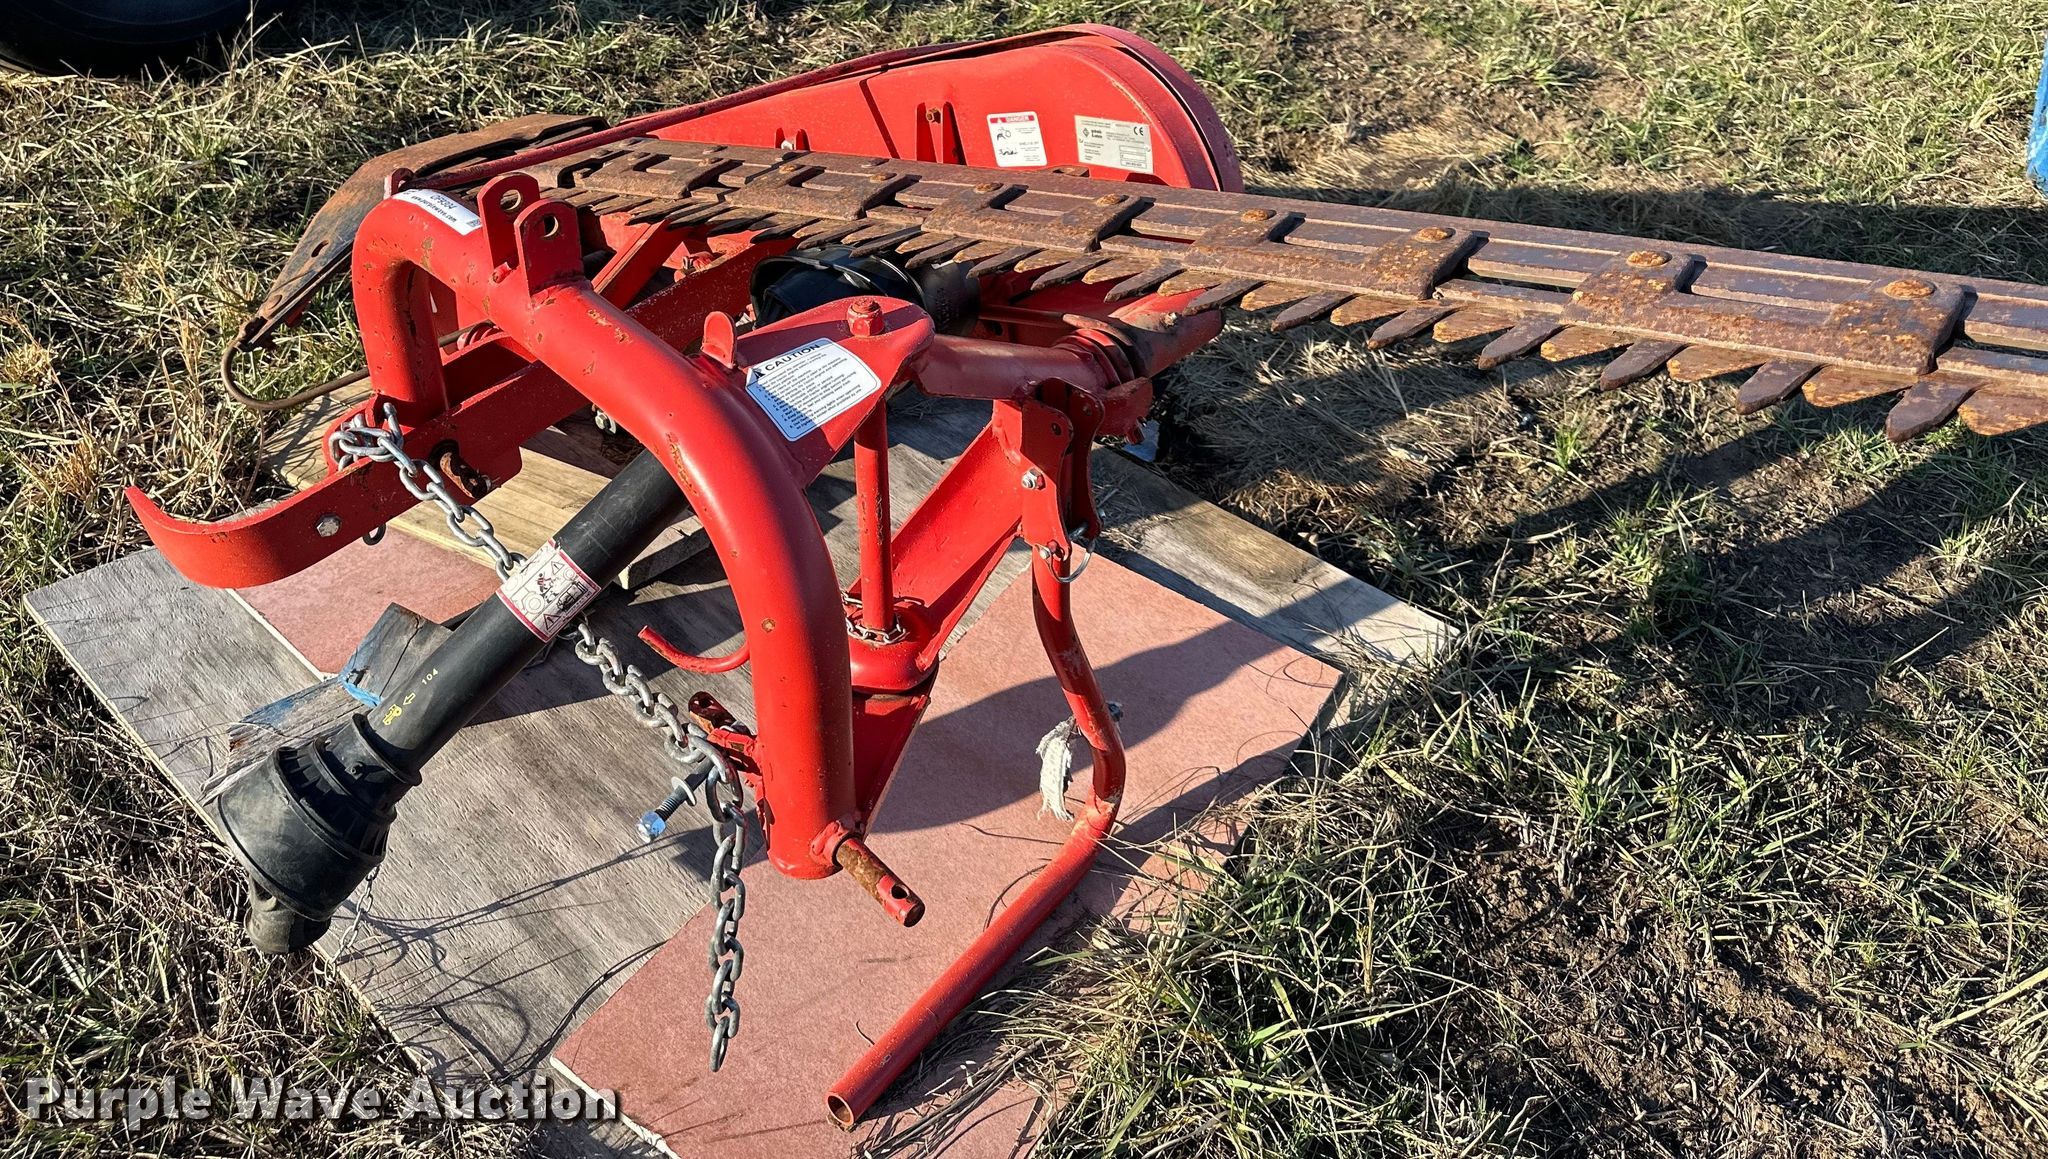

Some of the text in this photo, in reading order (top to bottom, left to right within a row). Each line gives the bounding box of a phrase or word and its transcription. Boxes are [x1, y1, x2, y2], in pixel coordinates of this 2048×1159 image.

[1133, 126, 1144, 136] CE
[765, 344, 821, 371] CAUTION
[421, 668, 439, 685] 104
